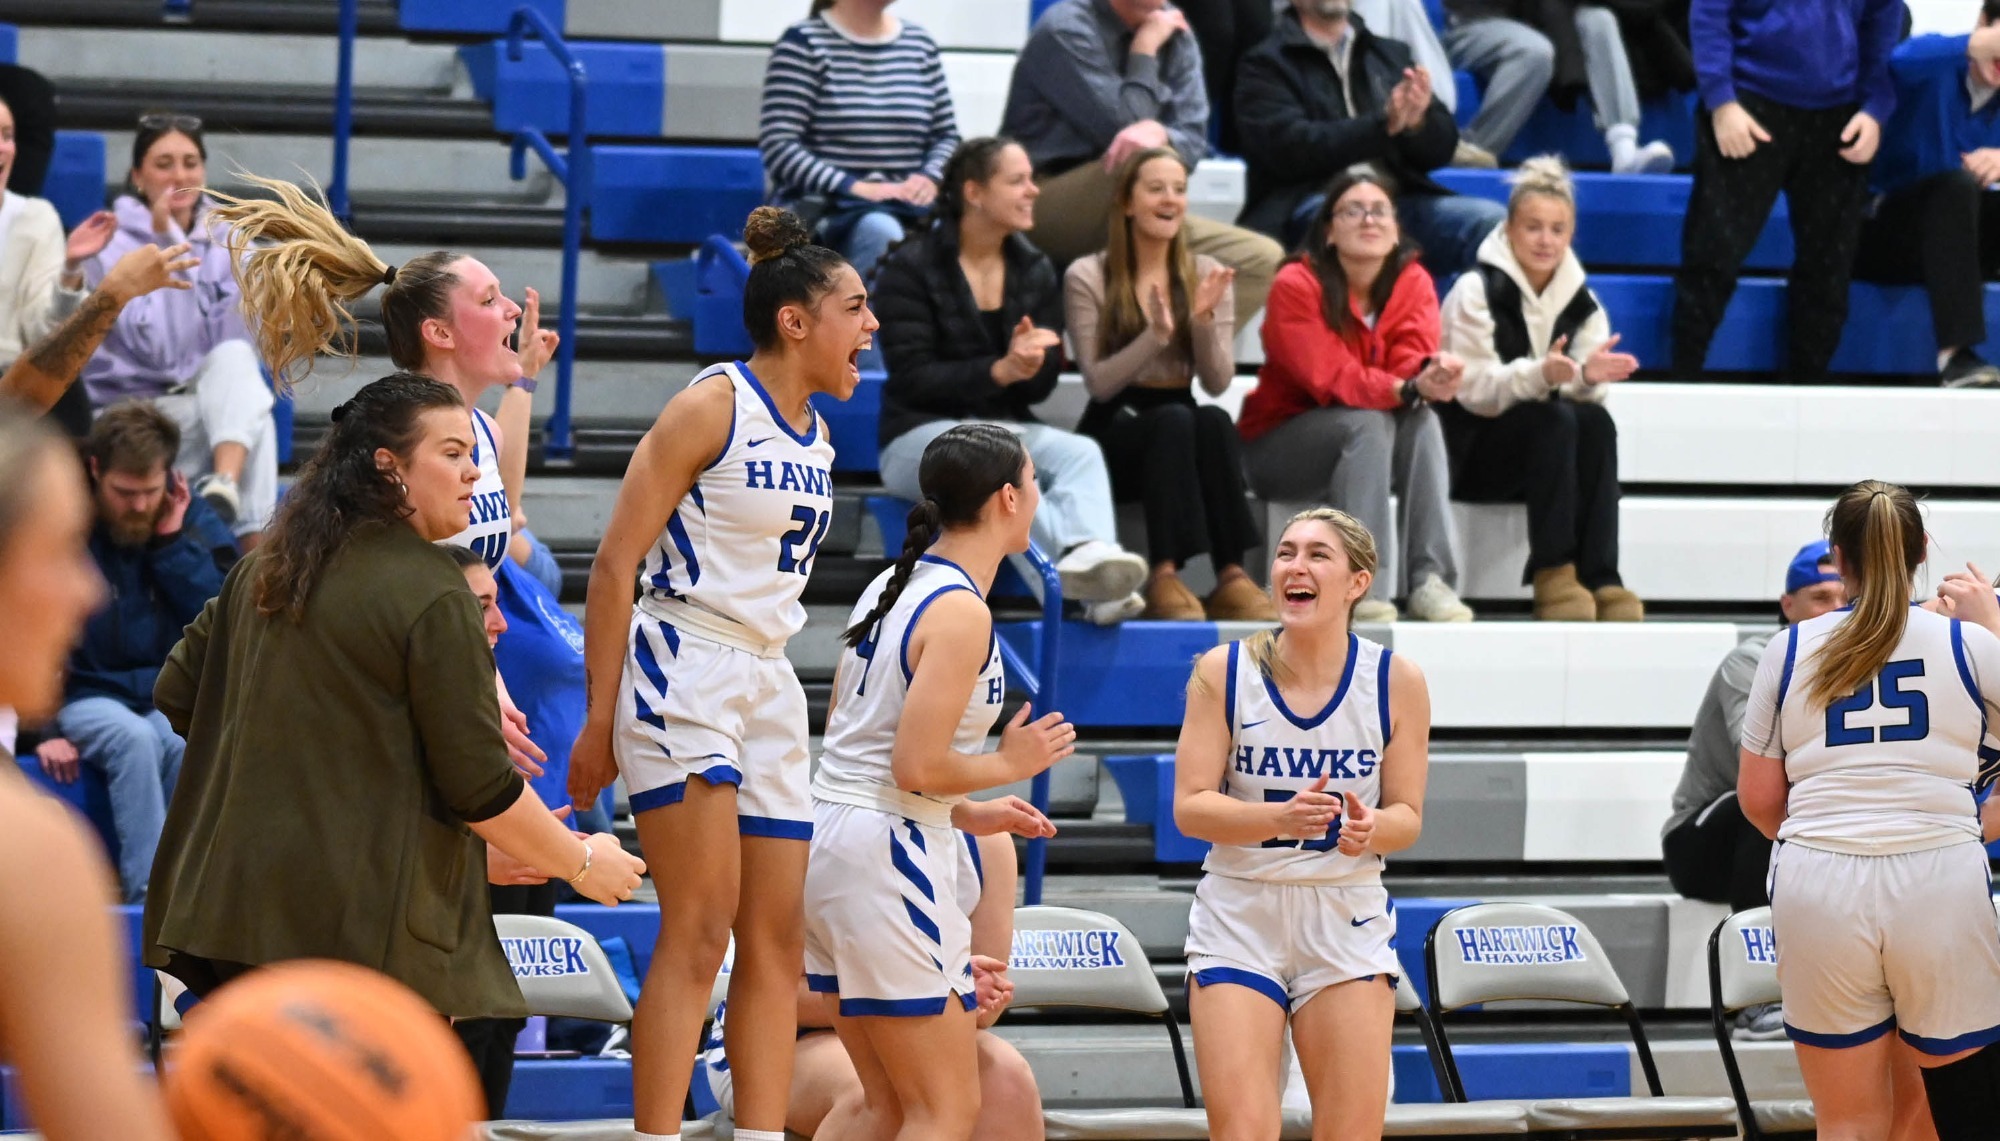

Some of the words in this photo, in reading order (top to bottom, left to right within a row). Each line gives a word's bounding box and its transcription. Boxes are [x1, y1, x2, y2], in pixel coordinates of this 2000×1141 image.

[1825, 658, 1930, 748] 25
[1235, 744, 1377, 779] HAWKS
[1455, 926, 1584, 962] HARTWICK
[1485, 952, 1564, 963] HAWKS
[1013, 957, 1101, 968] HAWKS
